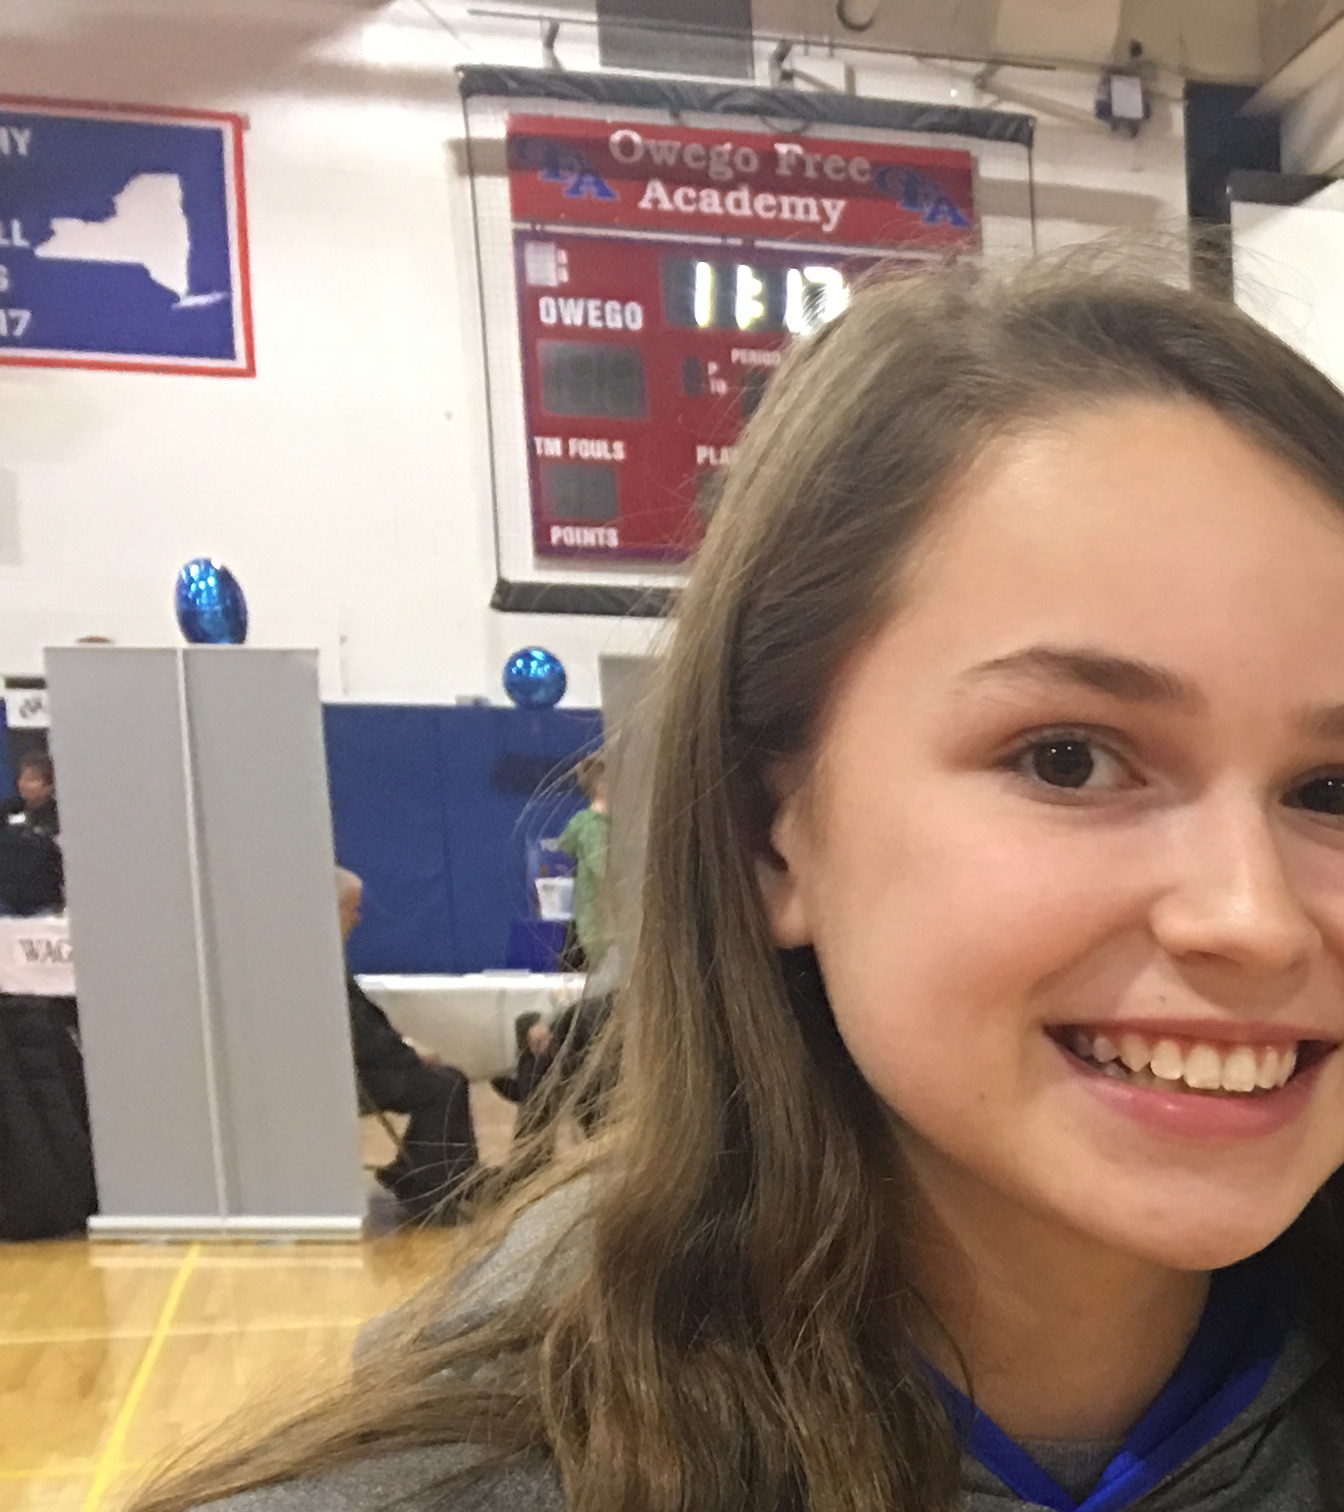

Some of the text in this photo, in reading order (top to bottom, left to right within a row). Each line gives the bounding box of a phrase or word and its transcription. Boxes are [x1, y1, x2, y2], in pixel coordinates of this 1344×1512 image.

[608, 129, 873, 183] Owego Free
[637, 178, 847, 233] Academy
[539, 296, 644, 332] OWEGO
[534, 436, 627, 462] TM FOULS
[550, 525, 620, 549] POINTS
